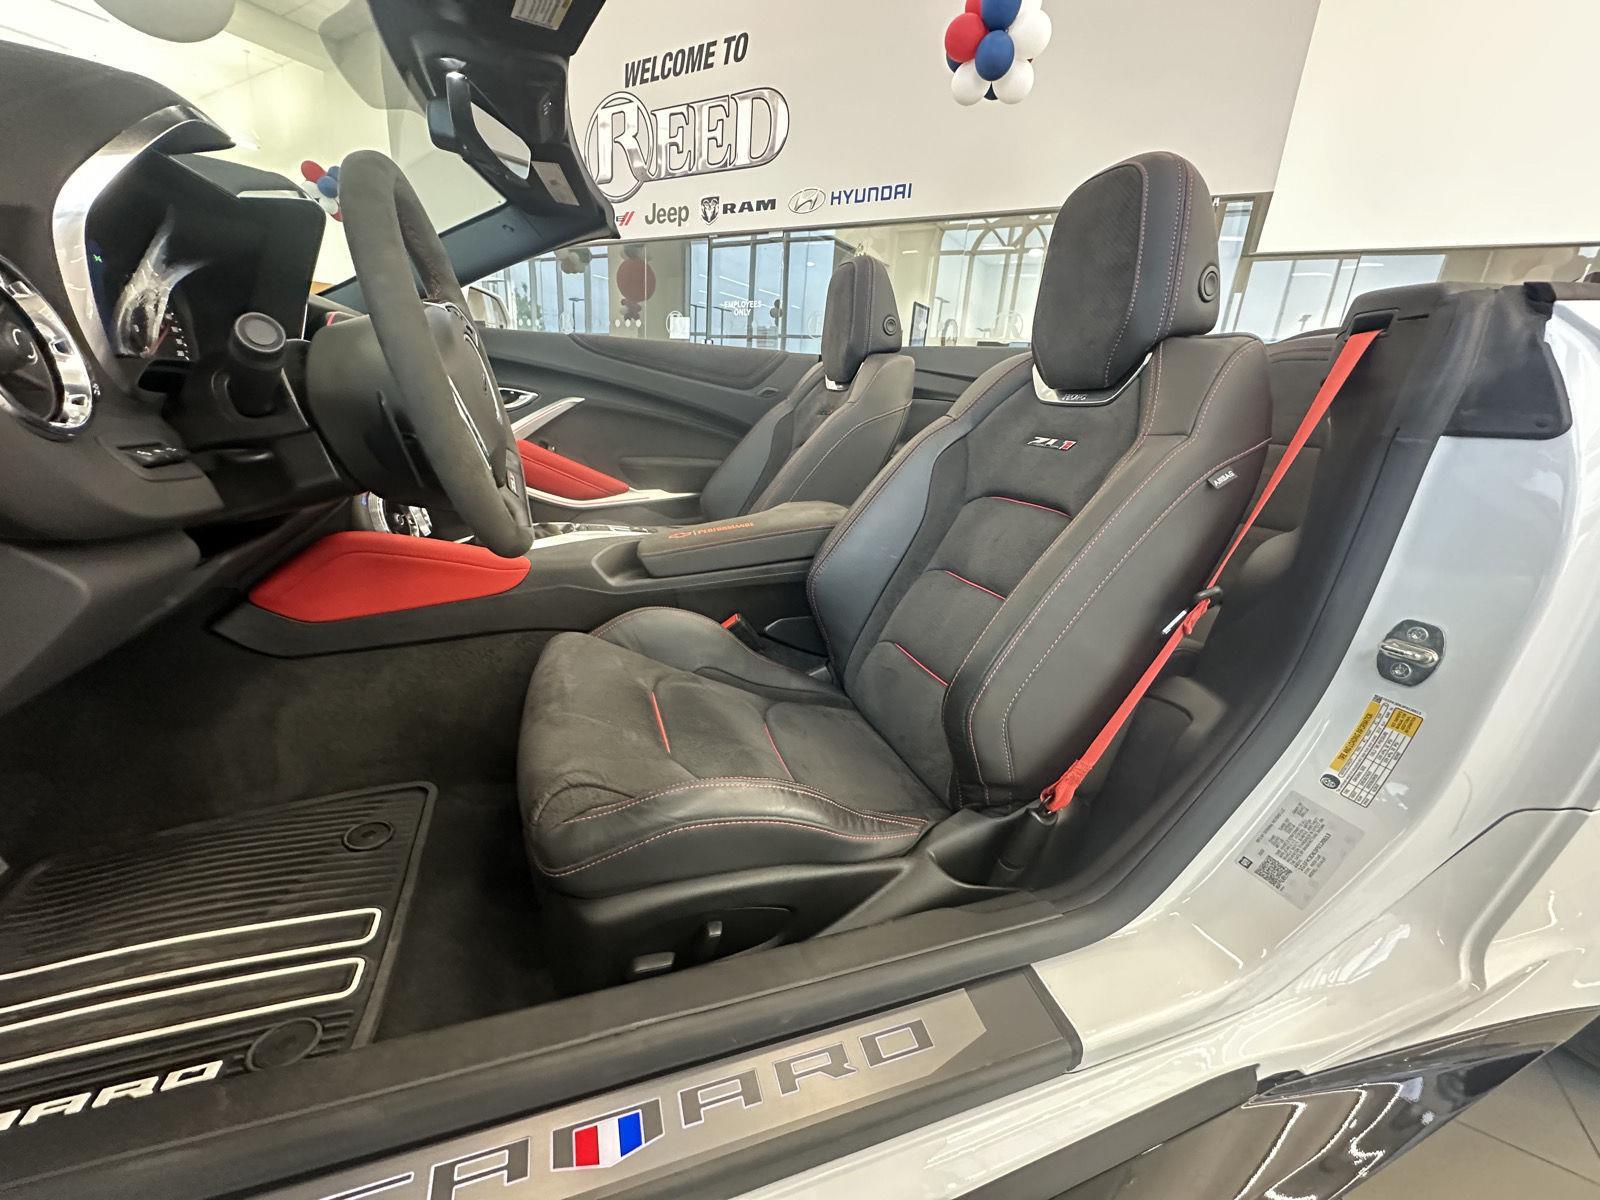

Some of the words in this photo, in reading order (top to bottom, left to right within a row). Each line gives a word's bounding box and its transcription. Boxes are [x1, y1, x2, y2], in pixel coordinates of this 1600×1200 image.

[624, 40, 717, 88] WELCOME
[723, 32, 749, 63] TO
[585, 87, 790, 197] REED
[830, 183, 913, 206] HYUNDAI
[645, 203, 689, 227] Jeep
[722, 198, 777, 215] RAM
[723, 300, 762, 309] EMPLOYEES
[733, 308, 751, 316] ONLY
[1027, 436, 1077, 451] ZL1
